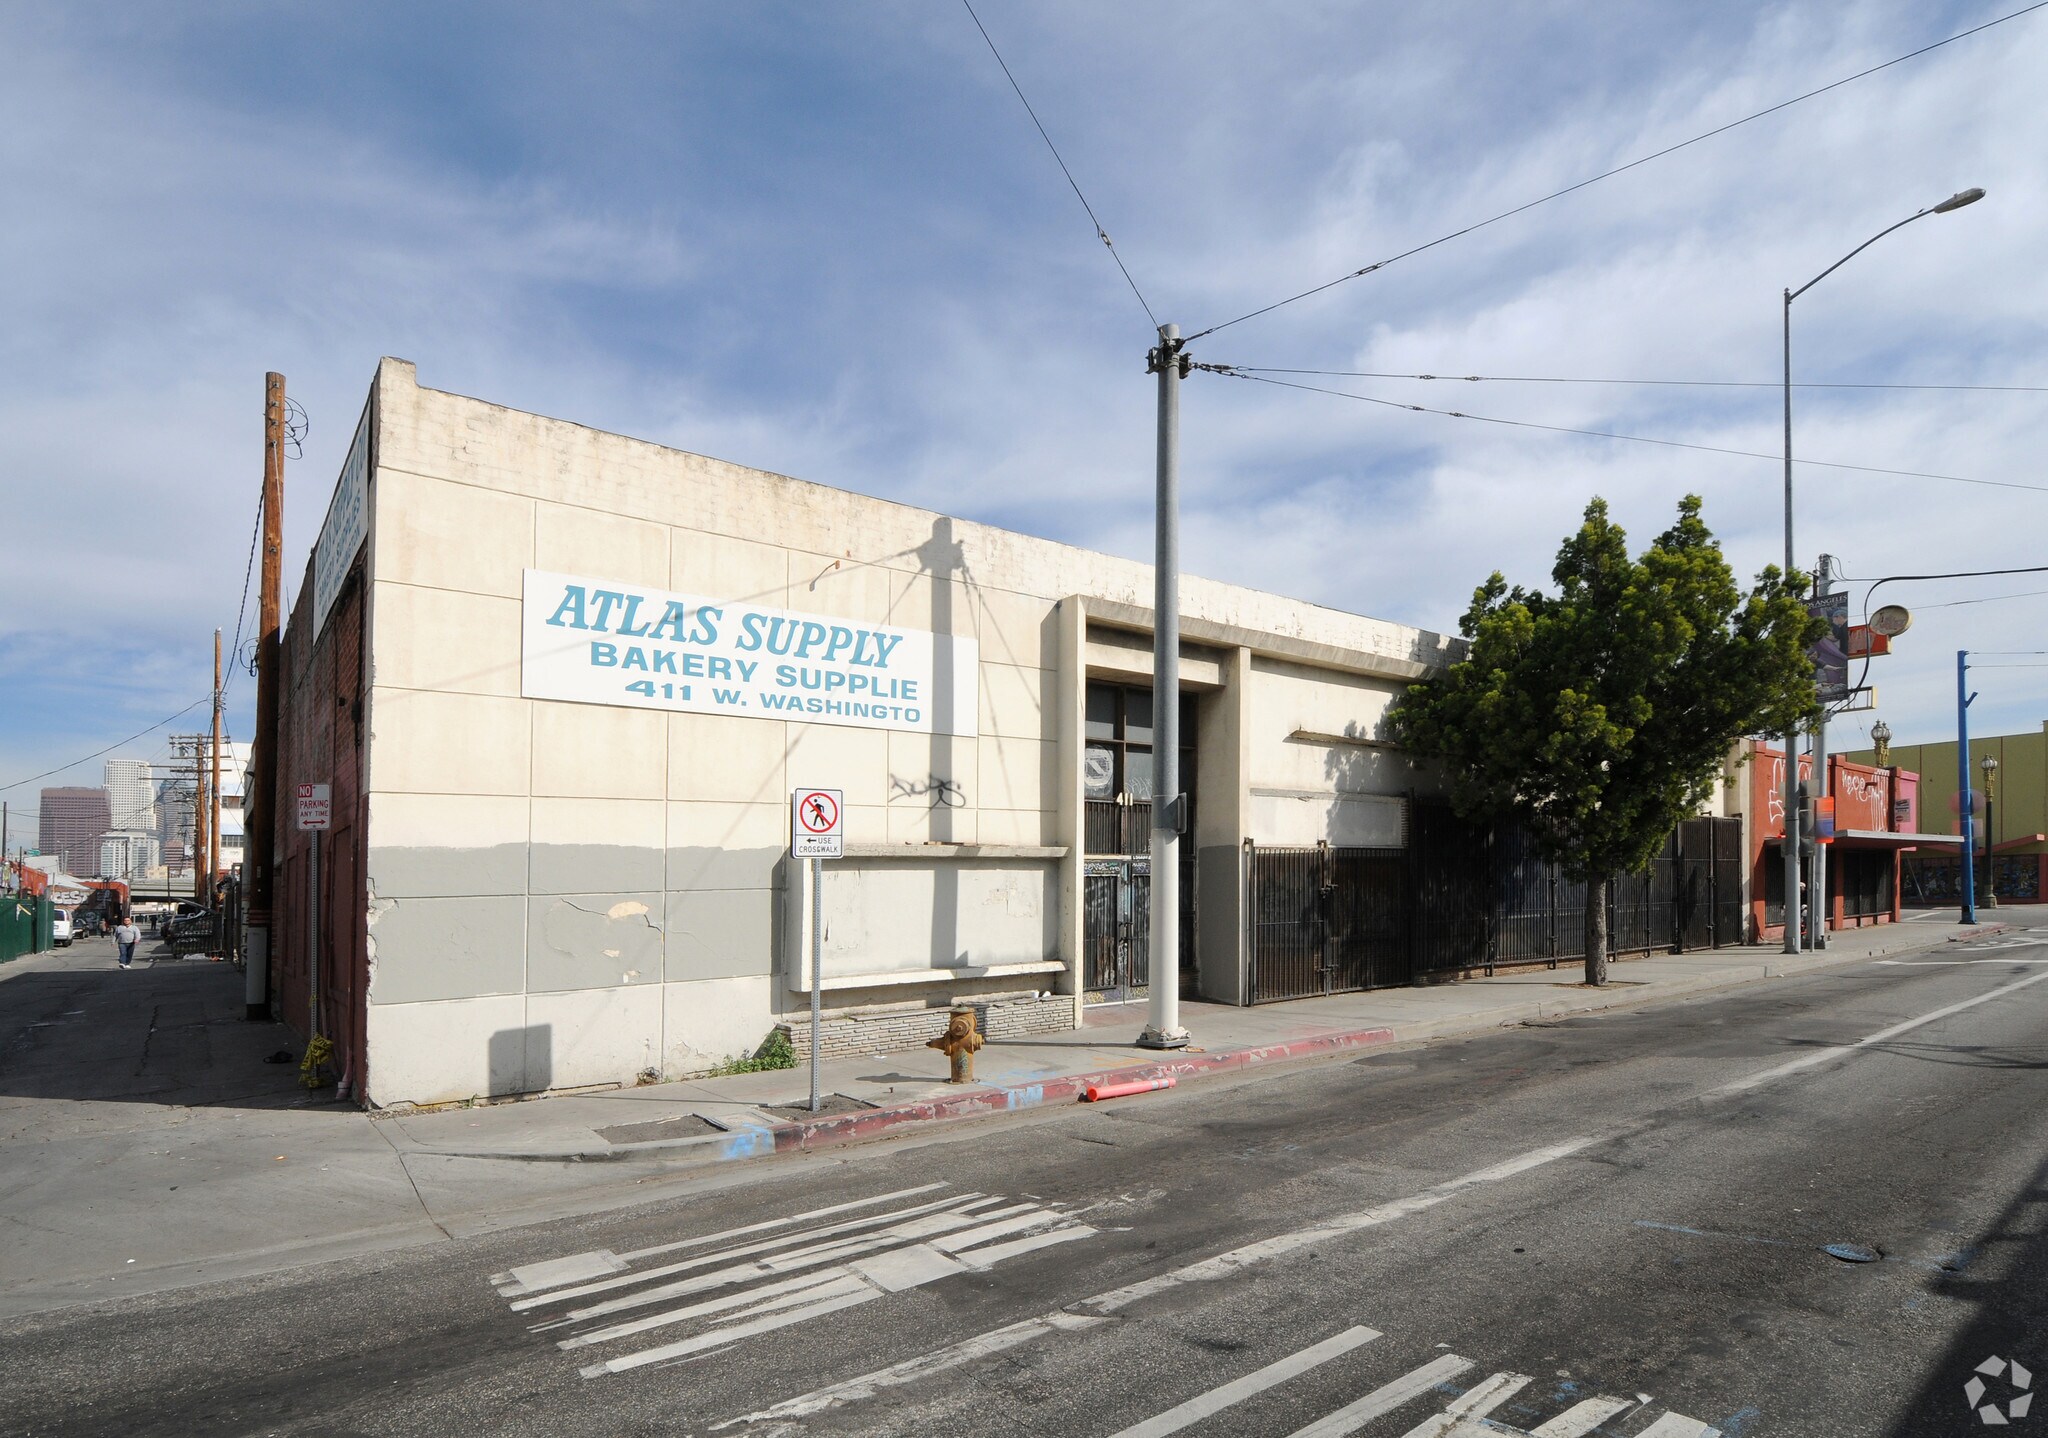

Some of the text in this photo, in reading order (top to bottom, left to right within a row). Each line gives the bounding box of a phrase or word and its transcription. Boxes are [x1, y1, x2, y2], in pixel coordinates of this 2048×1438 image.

[1814, 594, 1848, 608] ANGELES
[546, 585, 903, 668] ATLAS SUPPLY
[590, 641, 918, 700] BAKERY SUPPLIE
[625, 680, 921, 723] 411 W. WASHINGTO
[299, 785, 311, 796] NO
[300, 800, 329, 809] PARKING
[1116, 792, 1134, 806] 411
